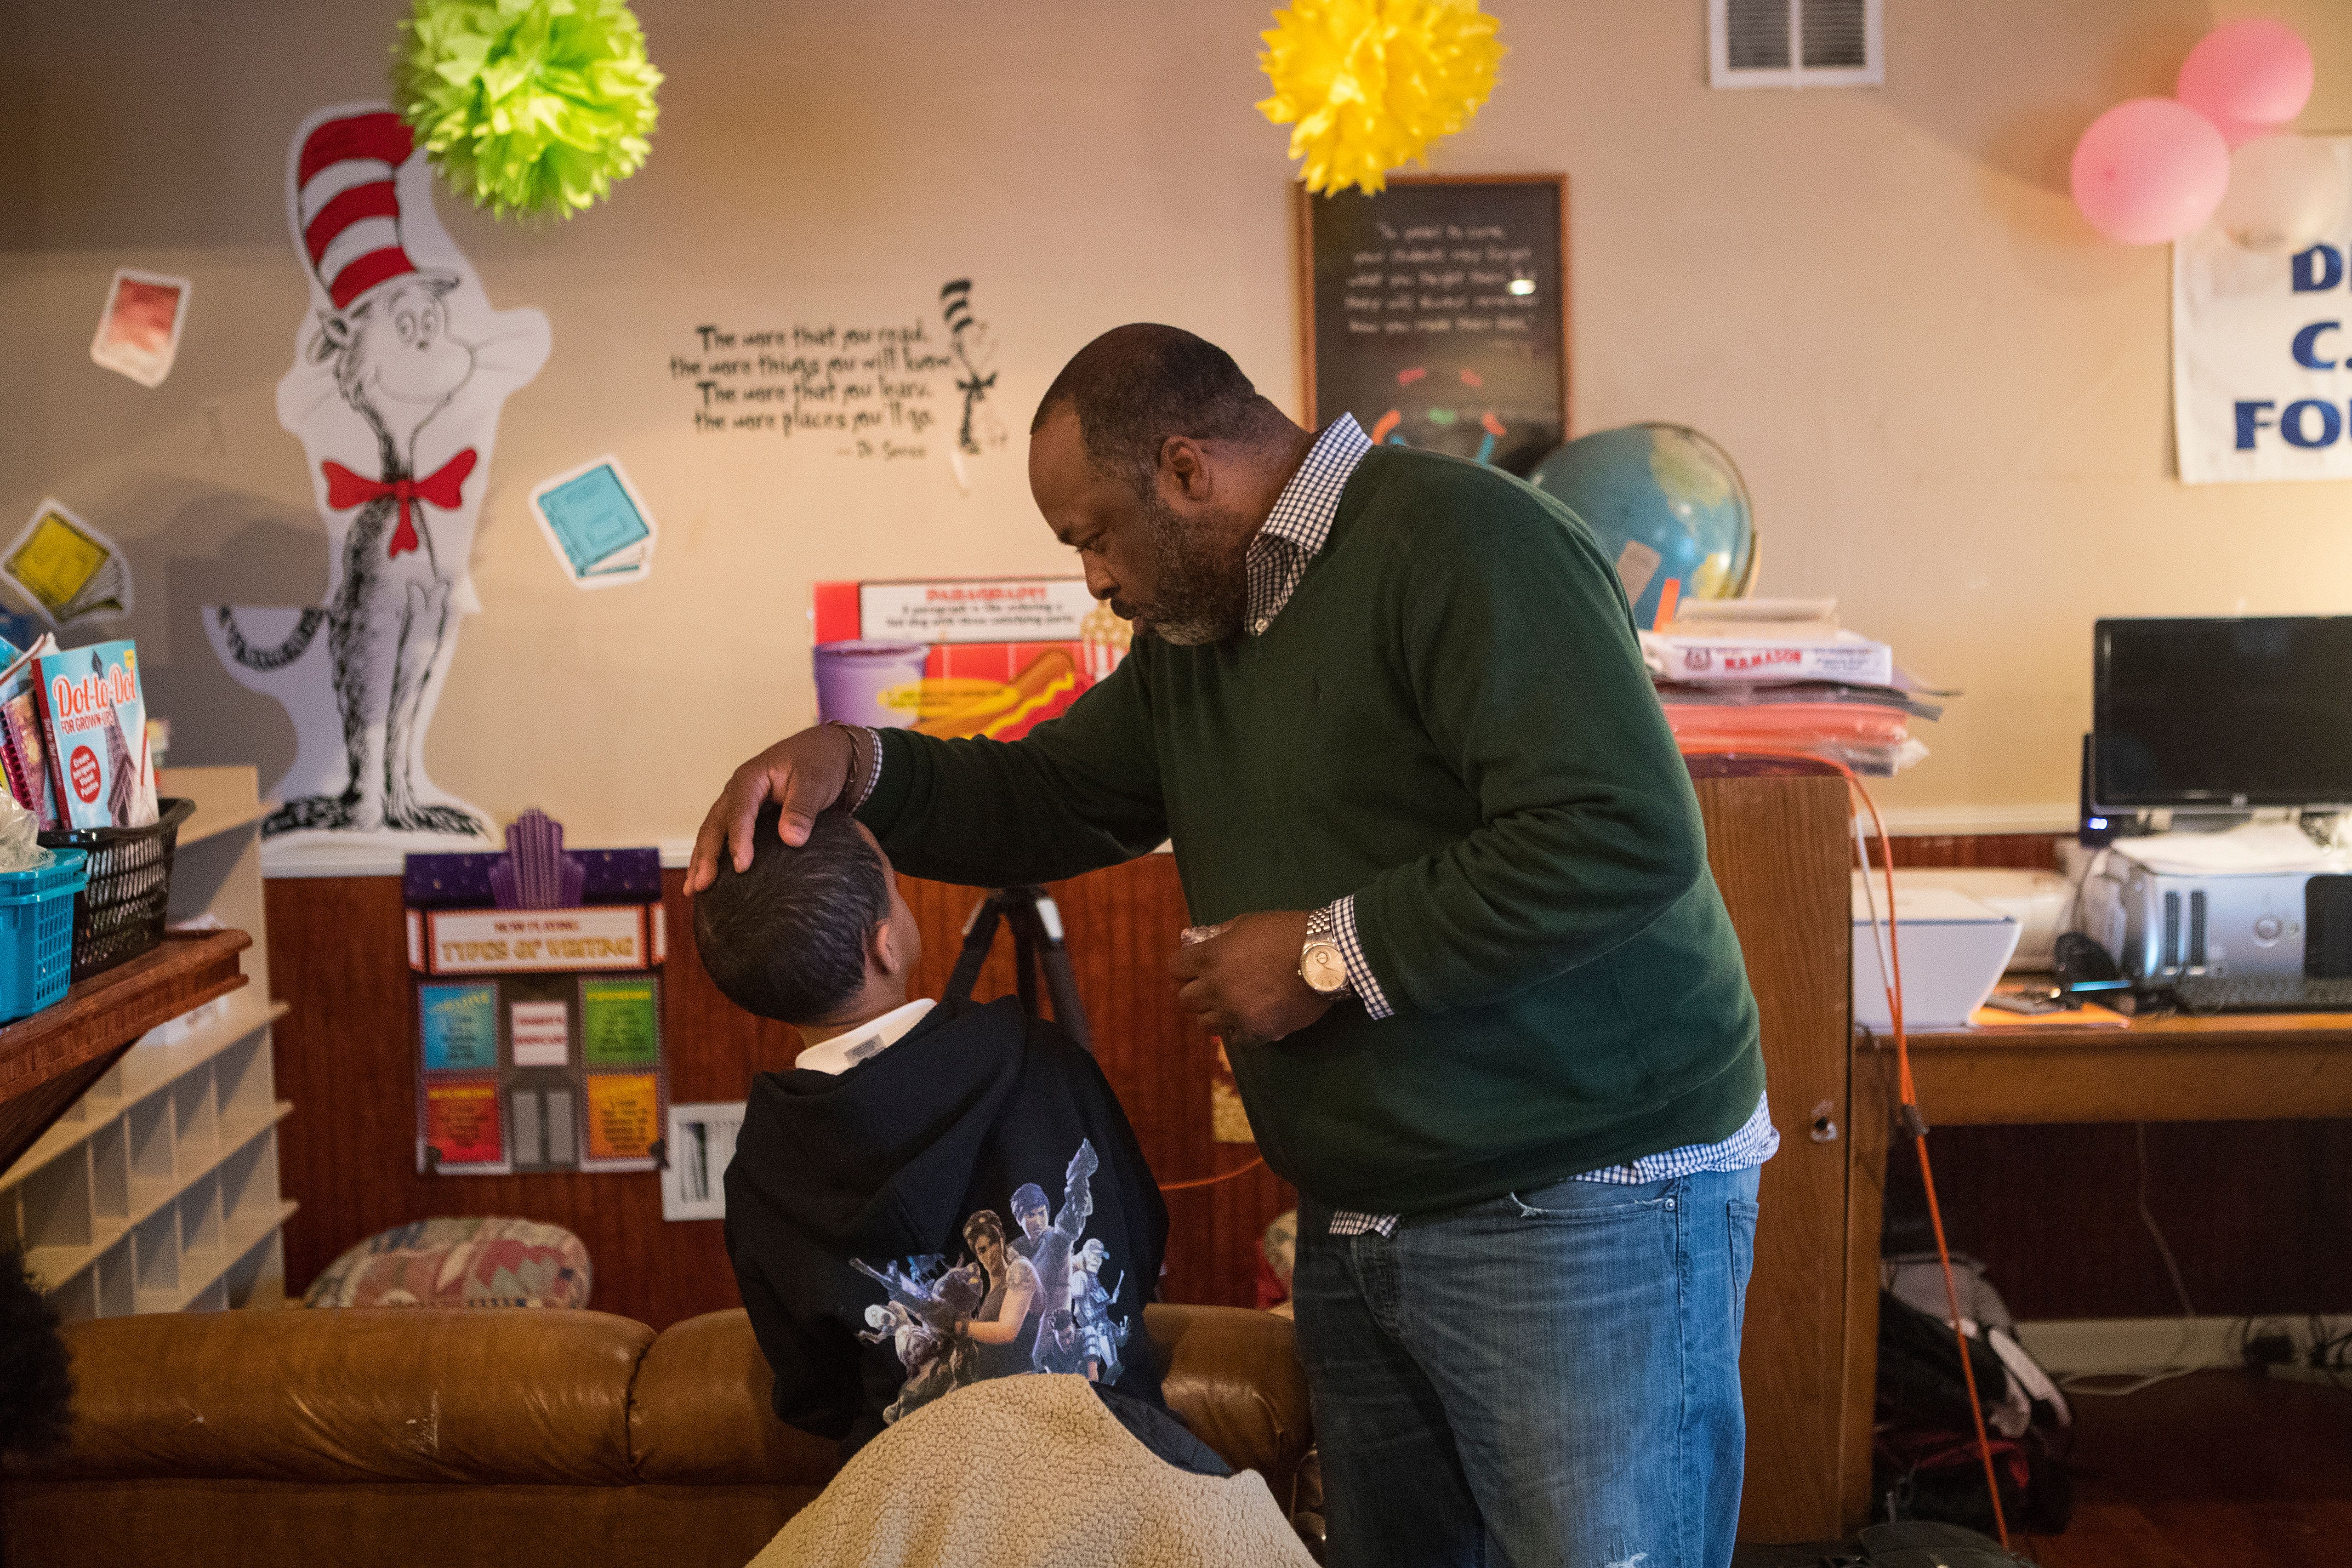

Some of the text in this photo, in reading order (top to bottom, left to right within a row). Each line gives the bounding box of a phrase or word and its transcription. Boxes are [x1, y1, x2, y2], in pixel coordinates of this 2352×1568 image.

[2291, 243, 2352, 294] D
[695, 324, 735, 353] The
[792, 323, 836, 347] that
[669, 354, 701, 379] the
[758, 355, 820, 385] things
[695, 380, 735, 407] The
[792, 380, 836, 402] that
[695, 411, 725, 433] the
[783, 399, 847, 438] places
[2234, 397, 2352, 451] FO
[61, 710, 115, 734] FOR GROWN-UPS
